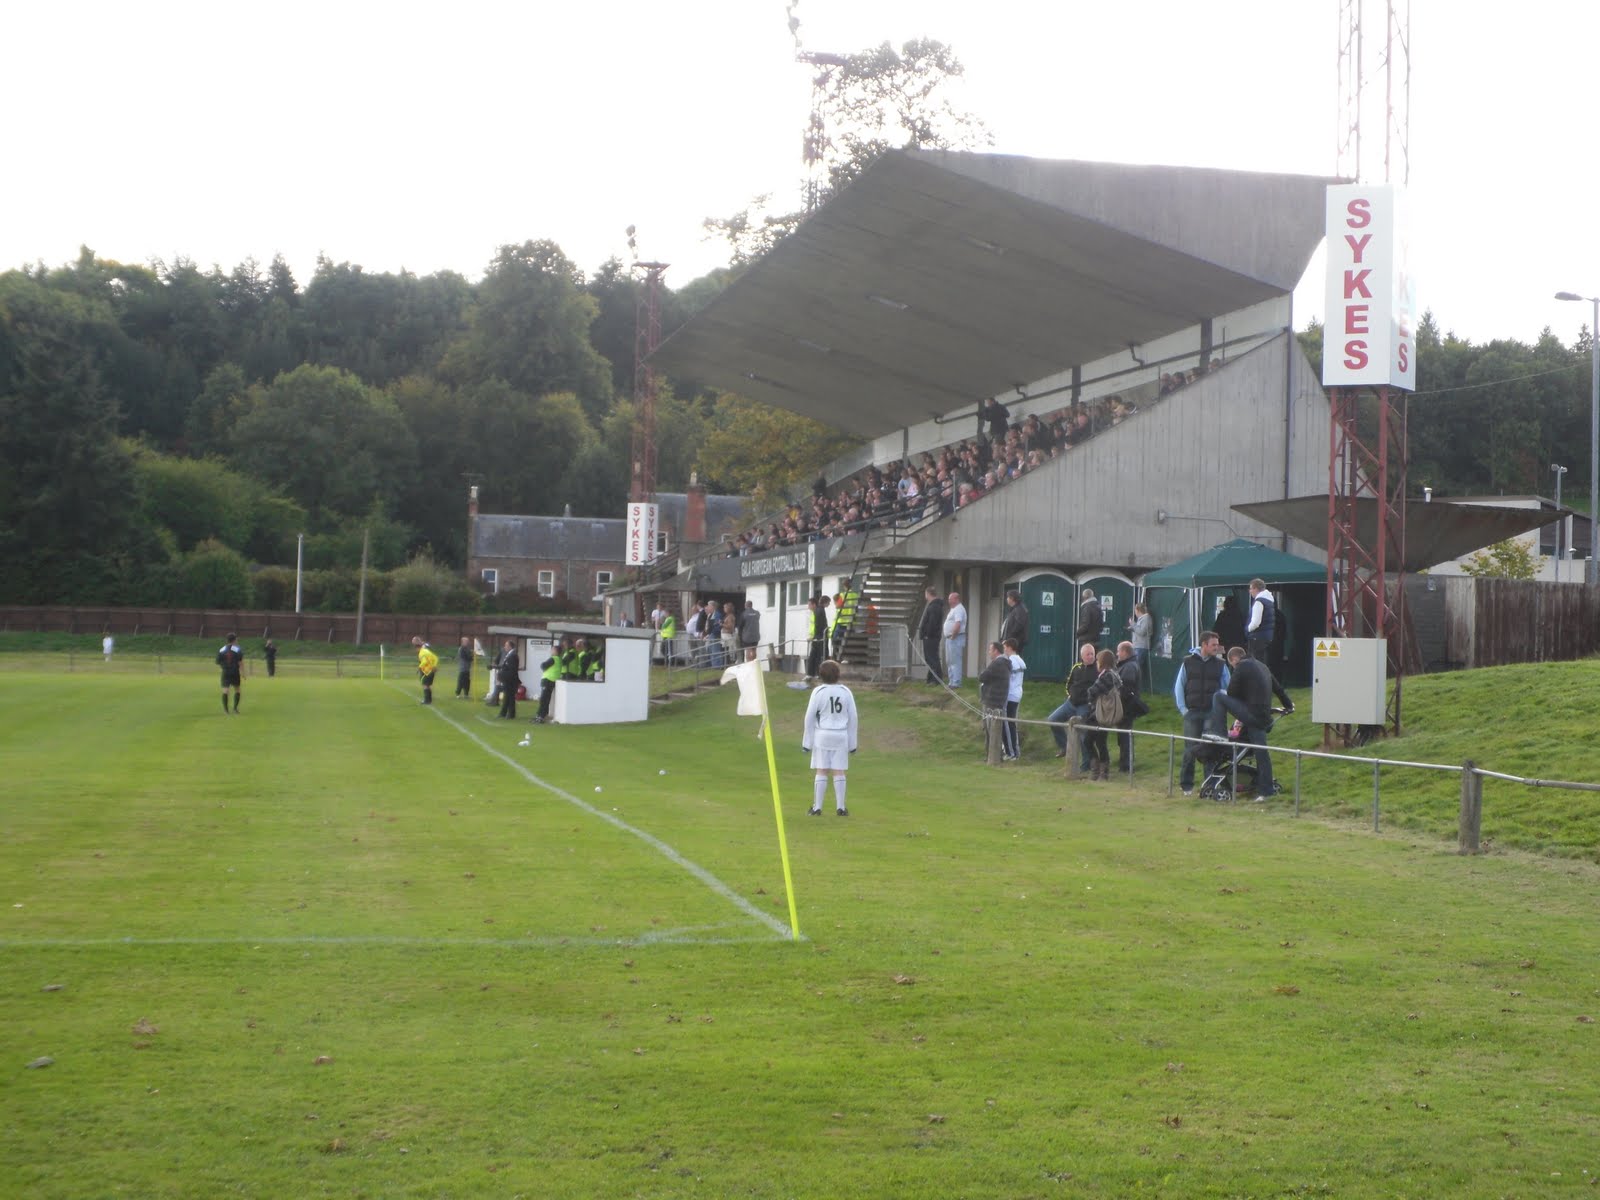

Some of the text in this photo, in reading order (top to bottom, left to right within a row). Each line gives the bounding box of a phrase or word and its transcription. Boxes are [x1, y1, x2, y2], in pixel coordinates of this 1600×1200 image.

[1343, 198, 1373, 370] SYKES
[632, 506, 641, 562] SYKES
[773, 556, 793, 573] FOOTBALL
[794, 552, 806, 570] CLUB
[829, 696, 842, 714] 16
